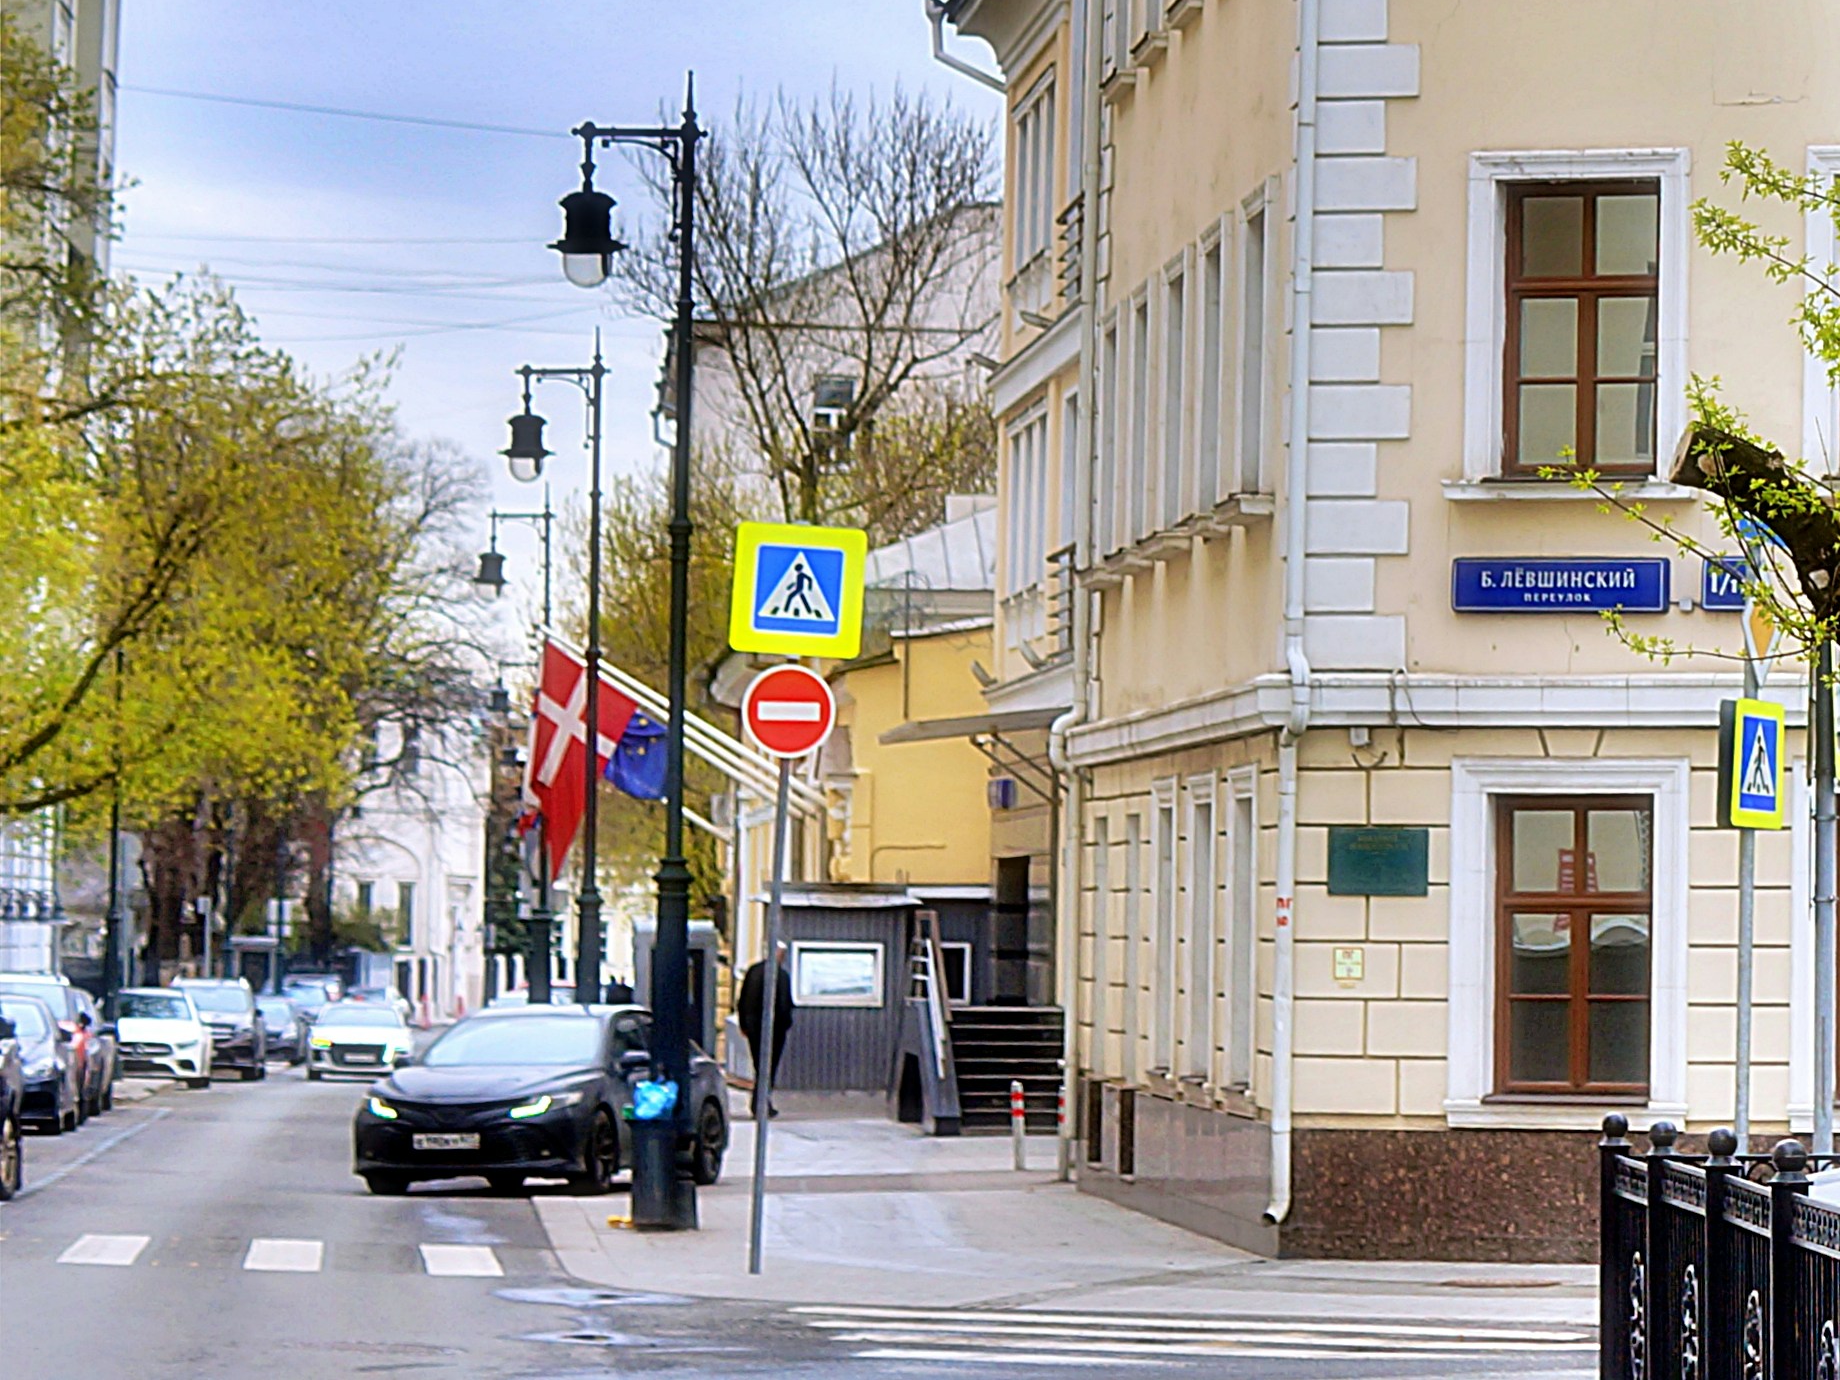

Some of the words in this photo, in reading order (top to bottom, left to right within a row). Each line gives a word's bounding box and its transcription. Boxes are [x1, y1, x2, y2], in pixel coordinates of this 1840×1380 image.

[1481, 571, 1497, 588] Б.
[1500, 567, 1635, 589] ЛЁВШИНСКИЙ
[1524, 592, 1591, 603] ПЕРЕУЛОК
